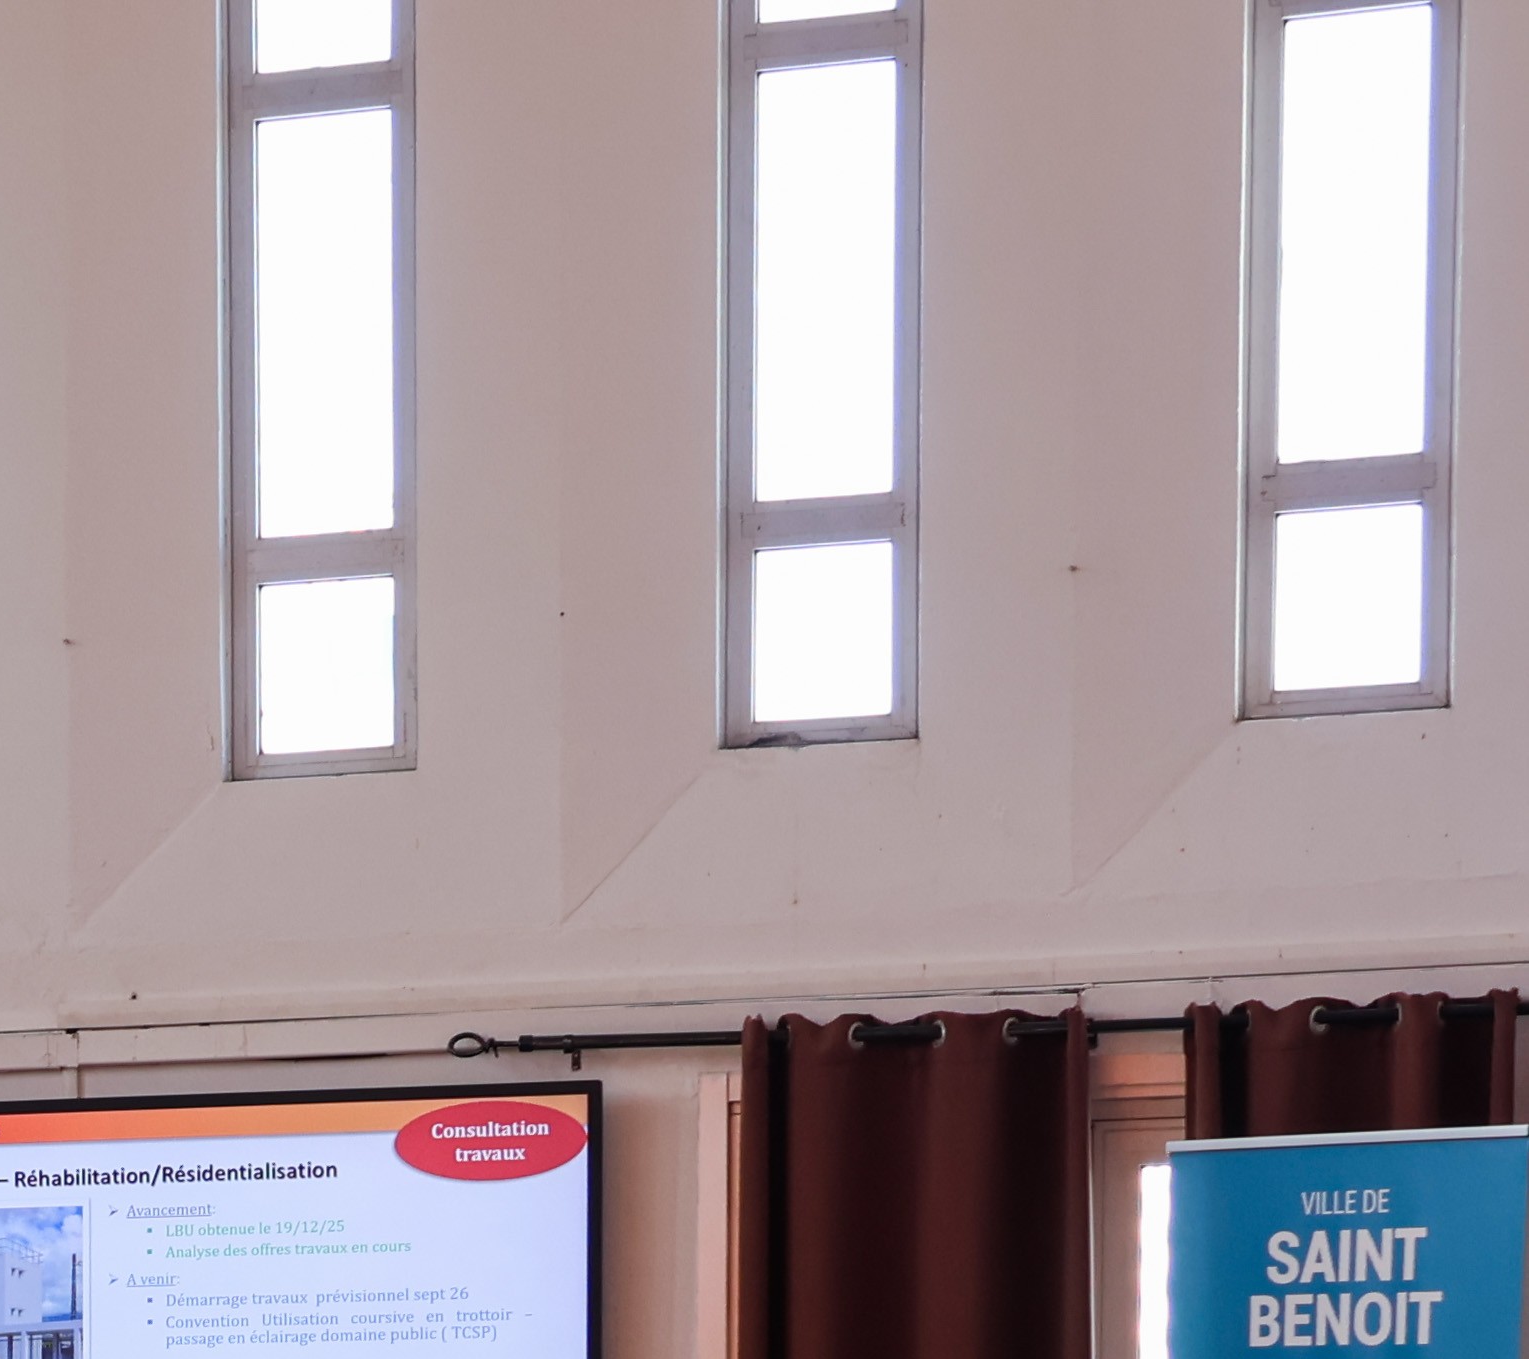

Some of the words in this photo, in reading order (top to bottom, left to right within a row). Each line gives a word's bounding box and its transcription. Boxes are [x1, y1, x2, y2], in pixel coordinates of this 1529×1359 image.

[431, 1121, 550, 1139] Consultation
[455, 1148, 525, 1162] travaux
[14, 1162, 337, 1188] Réhabilitation/Résidentialisation
[126, 1204, 216, 1218] Avancement:
[1301, 1190, 1356, 1215] VILLE
[1362, 1189, 1391, 1214] DE
[166, 1224, 194, 1237] LBU
[198, 1222, 255, 1236] obtenue
[259, 1222, 271, 1235] le
[276, 1220, 345, 1236] 19/12/25
[166, 1245, 219, 1260] Analyse
[223, 1243, 247, 1256] des
[251, 1242, 291, 1256] offres
[295, 1243, 347, 1255] travaux
[351, 1244, 368, 1253] en
[372, 1242, 411, 1253] cours
[1266, 1227, 1428, 1284] SAINT
[126, 1274, 136, 1287] A
[140, 1273, 180, 1287] venir:
[166, 1292, 247, 1309] Démarrage
[252, 1292, 308, 1305] travaux
[316, 1288, 410, 1306] prévisionnel
[413, 1288, 445, 1304] sept
[450, 1287, 469, 1300] 26
[166, 1315, 249, 1329] Convention
[262, 1313, 338, 1326] Utilisation
[351, 1311, 414, 1324] coursive
[426, 1312, 444, 1322] en
[456, 1310, 513, 1322] trottoir
[1249, 1291, 1444, 1347] BENOIT
[166, 1333, 224, 1349] passage
[228, 1335, 246, 1344] en
[250, 1330, 316, 1346] éclairage
[321, 1328, 387, 1343] domaine
[390, 1326, 437, 1344] public
